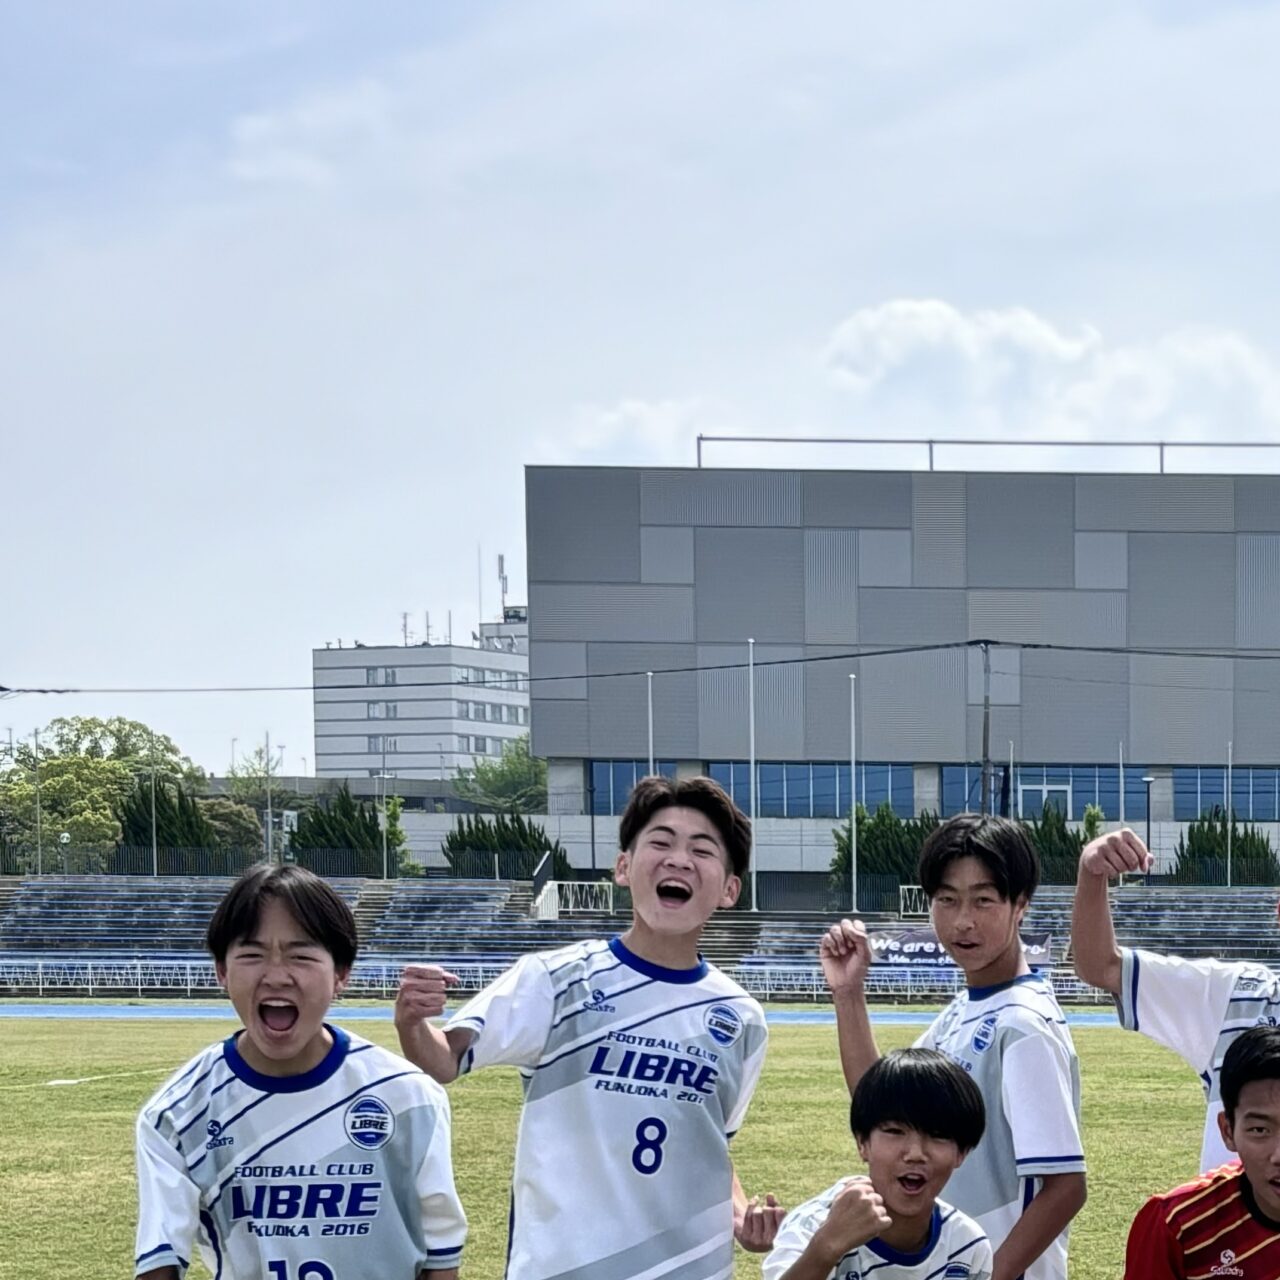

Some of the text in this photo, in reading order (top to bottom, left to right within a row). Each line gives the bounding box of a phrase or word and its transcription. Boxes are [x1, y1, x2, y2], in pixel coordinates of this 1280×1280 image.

[870, 938, 901, 952] We
[902, 941, 936, 954] are
[607, 1031, 681, 1053] FOOTBALL
[589, 1046, 719, 1095] LIBRE
[594, 1080, 669, 1099] FUKUOKA
[350, 1118, 390, 1131] LIBRE
[632, 1117, 668, 1175] 8
[233, 1163, 375, 1178] FOOTBALL CLUB
[230, 1182, 382, 1220] LIBRE
[320, 1222, 370, 1236] 2016
